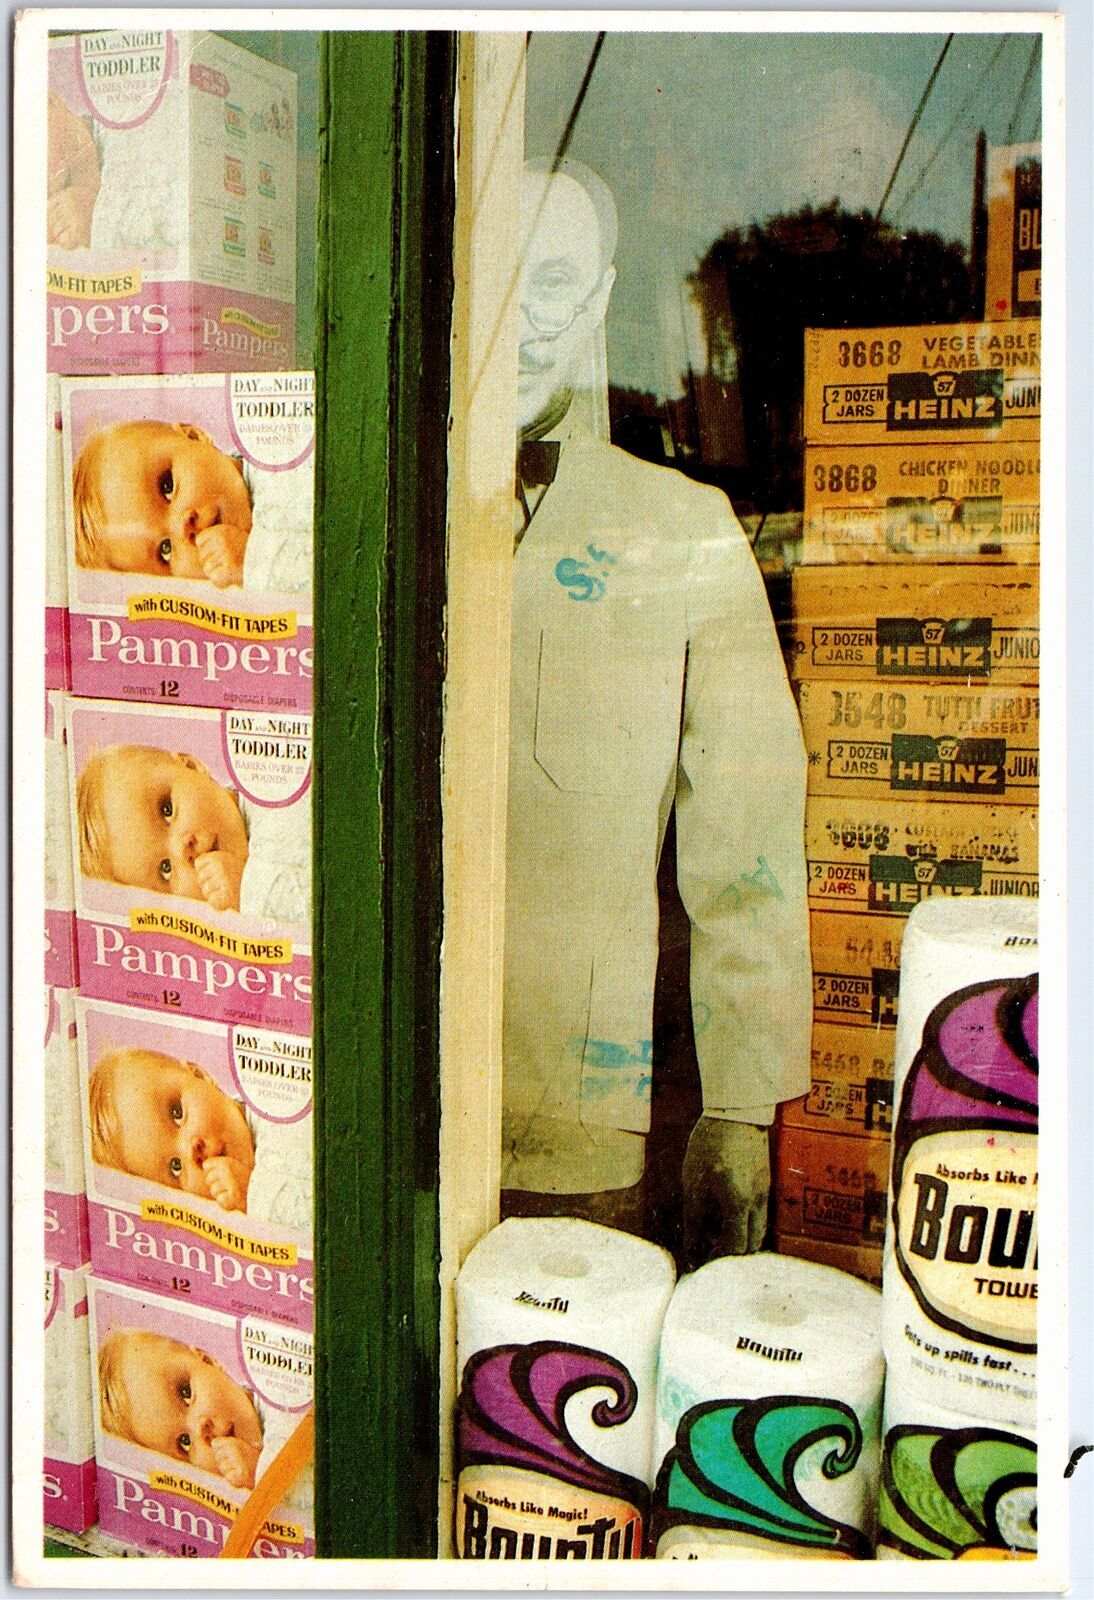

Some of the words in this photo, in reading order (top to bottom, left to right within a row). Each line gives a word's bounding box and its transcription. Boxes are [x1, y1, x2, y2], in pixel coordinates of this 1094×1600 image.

[84, 37, 107, 52] DAY
[122, 32, 162, 48] NIGHT
[87, 56, 161, 78] TODDLER
[92, 276, 133, 294] TAPES
[202, 317, 288, 358] Pampers
[838, 340, 902, 368] 3668
[922, 353, 979, 369] LAMB
[234, 379, 260, 393] DAY
[937, 381, 954, 393] 57
[831, 390, 840, 403] 2
[845, 389, 884, 402] DOZEN
[236, 402, 314, 417] TODDLER
[836, 405, 875, 417] JARS
[894, 396, 996, 420] HEINZ
[813, 463, 878, 492] 3868
[899, 460, 967, 477] CHICKEN
[937, 478, 1001, 495] DINNER
[134, 599, 157, 612] with
[160, 598, 241, 630] CUSTOM-FIT
[245, 618, 288, 633] TAPES
[820, 633, 829, 646] 2
[834, 633, 873, 646] DOZEN
[925, 628, 942, 641] 57
[88, 618, 313, 681] Pampers
[826, 649, 864, 661] JARS
[882, 645, 986, 668] HEINZ
[159, 680, 180, 698] 12
[231, 716, 255, 731] DAY
[268, 719, 311, 735] NIGHT
[232, 738, 307, 760] TODDLER
[836, 746, 844, 757] 2
[849, 746, 888, 761] DOZEN
[841, 761, 879, 774] JARS
[898, 762, 1000, 784] HEINZ
[815, 866, 823, 878] 2
[828, 866, 866, 881] DOZEN
[917, 868, 932, 879] 57
[819, 882, 857, 895] JARS
[136, 910, 158, 926] with
[161, 915, 238, 953] CUSTOM-FIT
[242, 941, 283, 959] TAPES
[92, 925, 312, 1004] Pampers
[817, 978, 826, 991] 2
[831, 980, 869, 995] DOZEN
[161, 989, 182, 1007] 12
[823, 994, 860, 1008] JARS
[236, 1034, 260, 1049] DAY
[272, 1041, 312, 1059] NIGHT
[238, 1054, 311, 1082] TODDLER
[812, 1084, 820, 1097] 2
[936, 1163, 990, 1182] Absorbs
[996, 1170, 1027, 1185] Like
[147, 1204, 169, 1217] with
[170, 1207, 245, 1251] CUSTOM-FIT
[249, 1242, 290, 1261] TAPES
[103, 1208, 313, 1302] Pampers
[170, 1276, 191, 1294] 12
[245, 1327, 267, 1342] DAY
[736, 1336, 803, 1362] Bounty
[925, 1343, 940, 1357] up
[944, 1350, 978, 1365] spills
[156, 1474, 178, 1488] with
[263, 1520, 296, 1538] APES
[476, 1490, 516, 1510] Absorbs
[520, 1502, 544, 1515] Like
[548, 1506, 588, 1521] Magic!
